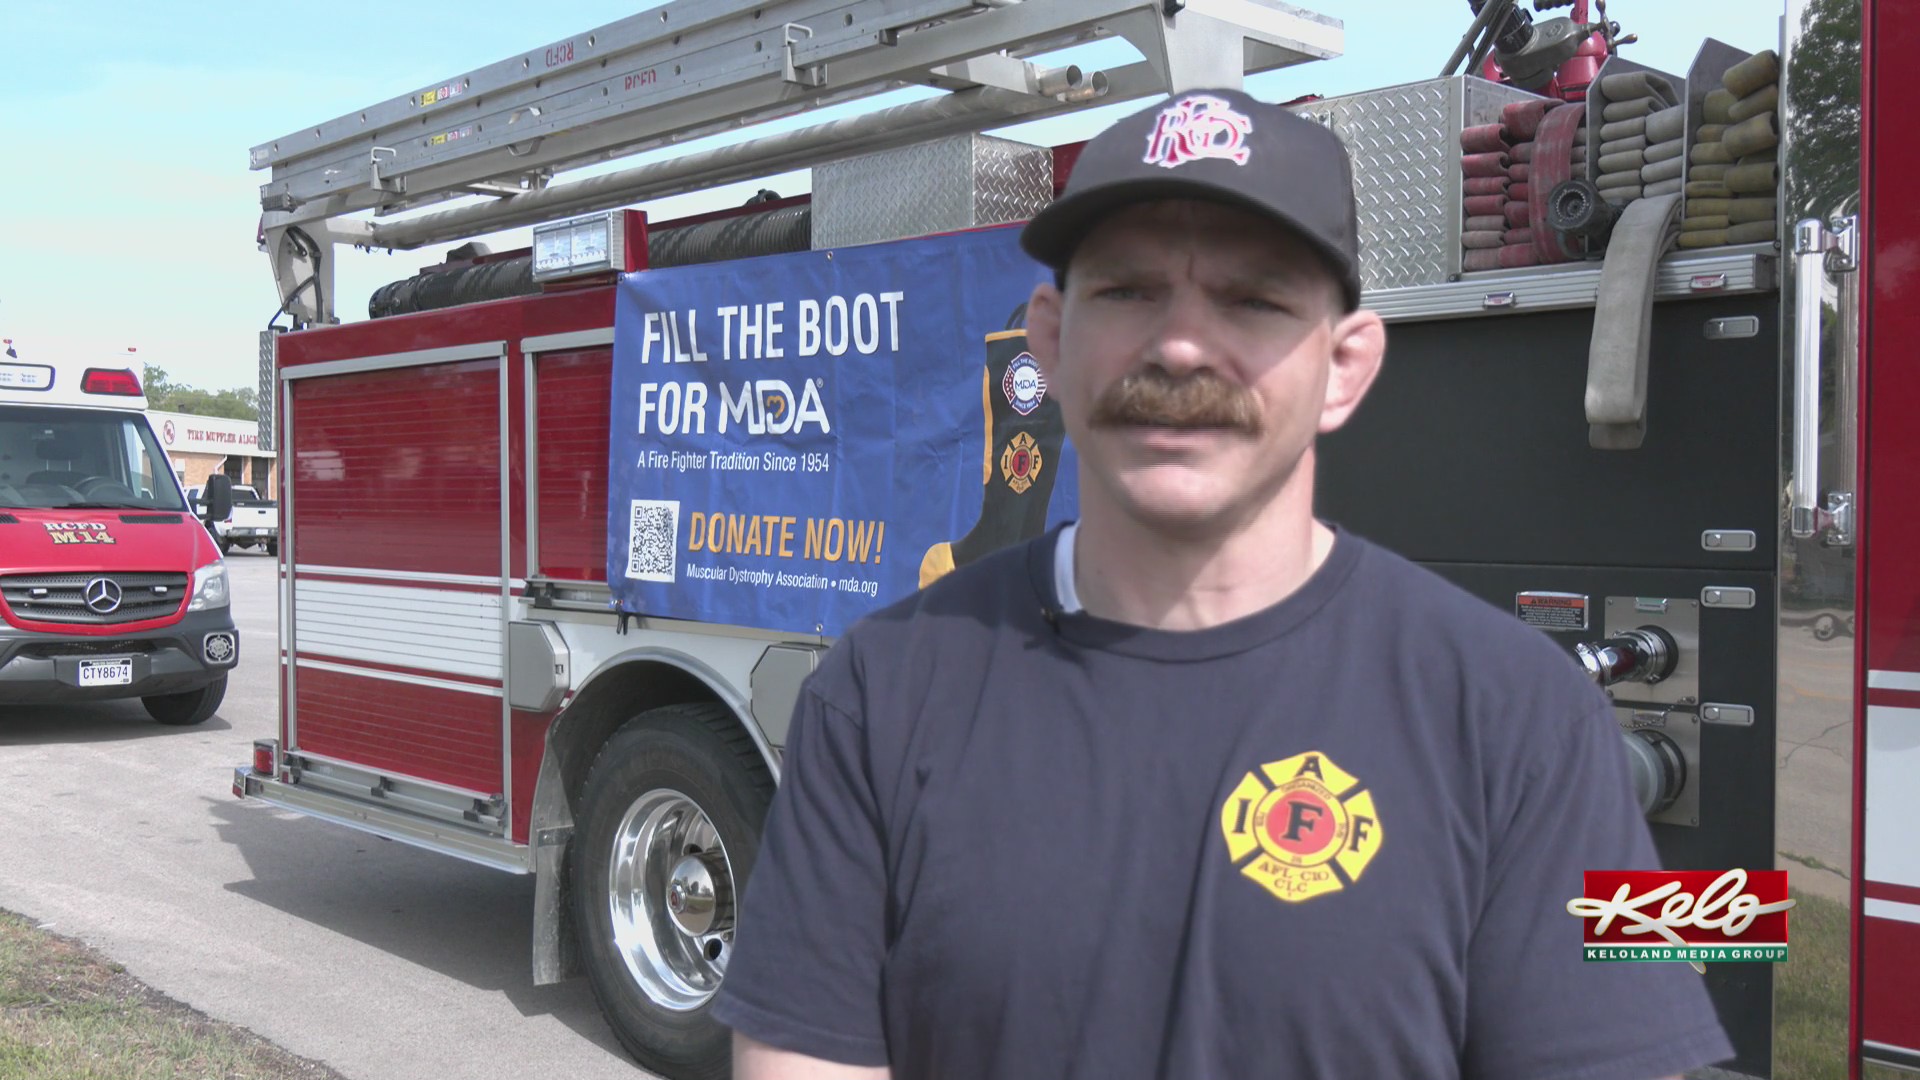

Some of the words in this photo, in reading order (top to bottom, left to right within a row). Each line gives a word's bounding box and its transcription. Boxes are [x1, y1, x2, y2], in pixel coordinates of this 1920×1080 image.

[546, 41, 574, 68] RCFD
[641, 309, 708, 364] FILL
[717, 302, 784, 360] THE
[798, 291, 904, 357] BOOT
[1015, 379, 1037, 390] MDA
[638, 381, 708, 435] FOR
[637, 451, 647, 468] A
[648, 451, 669, 469] Fire
[671, 451, 708, 473] Fighter
[709, 451, 760, 471] Tradition
[763, 451, 796, 472] Since
[801, 452, 830, 472] 1954
[43, 522, 107, 532] RCFD
[49, 531, 117, 544] M14
[688, 511, 797, 558] DONATE
[804, 517, 885, 564] NOW!
[686, 564, 728, 581] Muscular
[729, 568, 774, 588] Dystrophy
[775, 572, 828, 590] Association
[838, 577, 879, 597] mda.org
[83, 666, 128, 680] CTY8674
[1295, 755, 1325, 783] A
[1231, 797, 1252, 835] I
[1281, 801, 1323, 842] F
[1348, 814, 1374, 853] F
[1273, 878, 1308, 893] CLC
